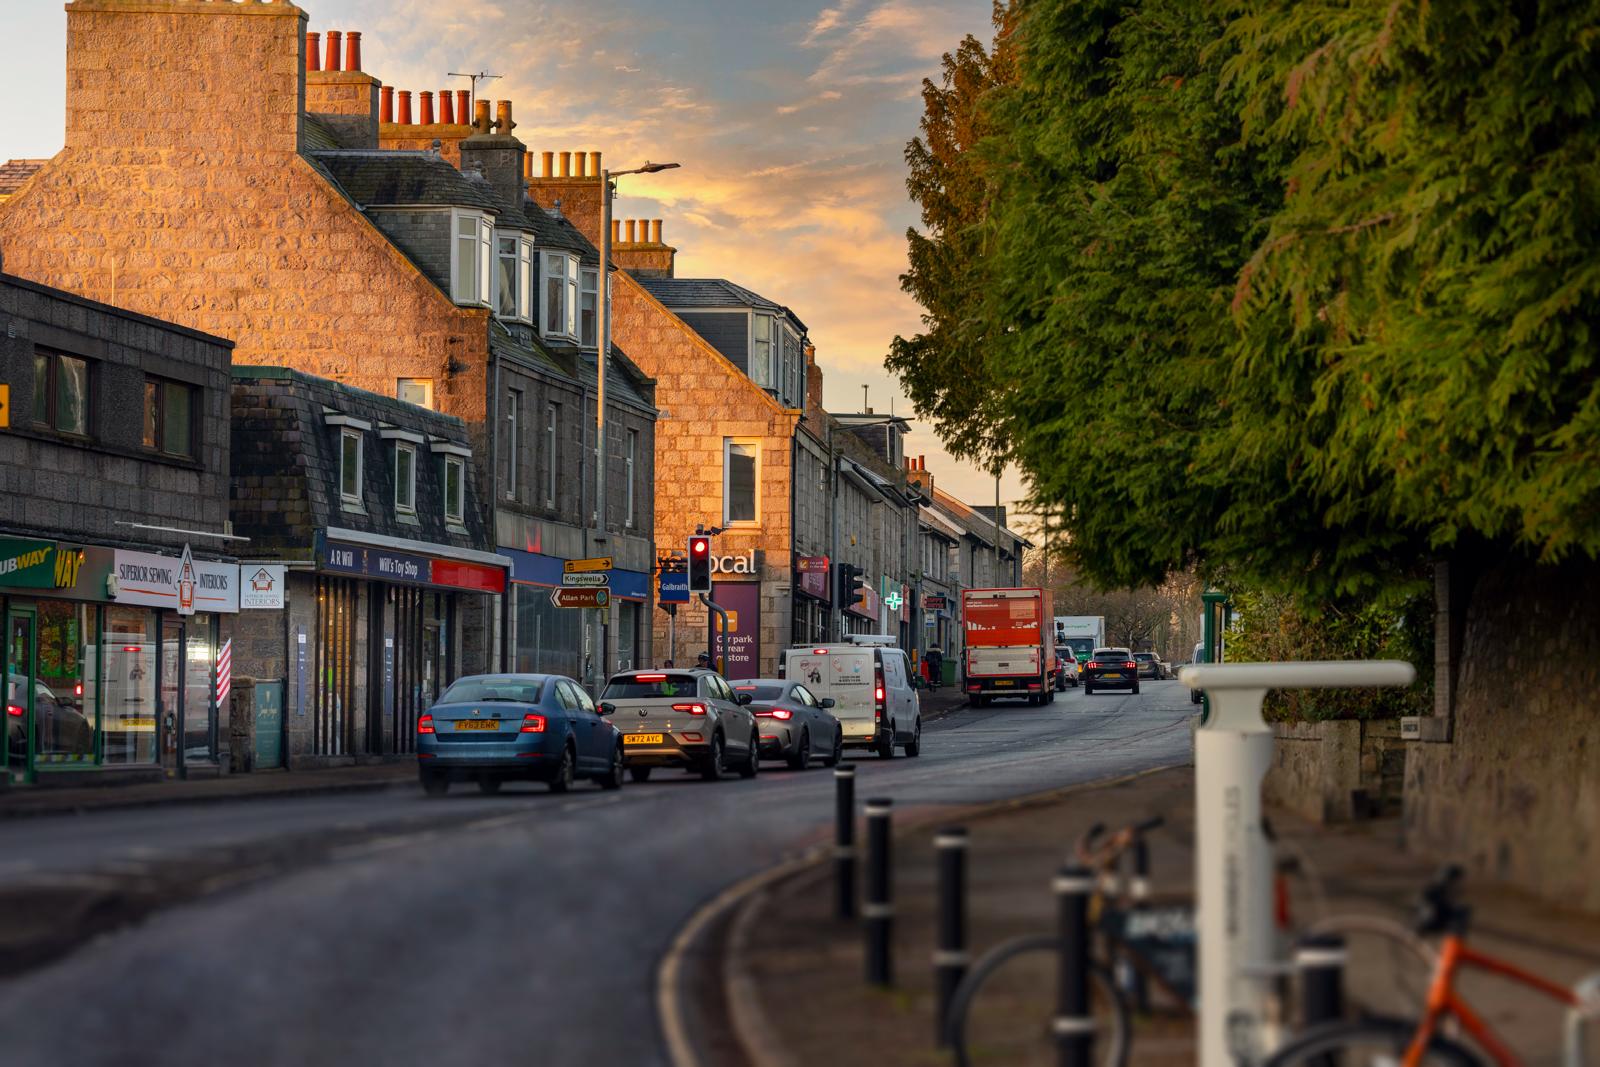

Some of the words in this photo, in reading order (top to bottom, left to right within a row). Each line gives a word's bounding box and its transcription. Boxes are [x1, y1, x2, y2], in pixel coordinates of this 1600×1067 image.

[0, 546, 53, 575] UBWAY
[330, 549, 335, 564] A
[336, 550, 341, 566] R
[342, 551, 353, 567] Will
[379, 557, 394, 573] Will's
[394, 560, 404, 577] Toy
[404, 561, 418, 579] Shop
[711, 548, 756, 574] ocal
[120, 563, 149, 583] SUPERIOR
[149, 567, 172, 585] SEWING
[200, 573, 228, 591] INTERIORS
[564, 574, 601, 584] Kingswells
[661, 583, 688, 591] Galbraith
[716, 635, 731, 643] Cr
[733, 635, 753, 645] park
